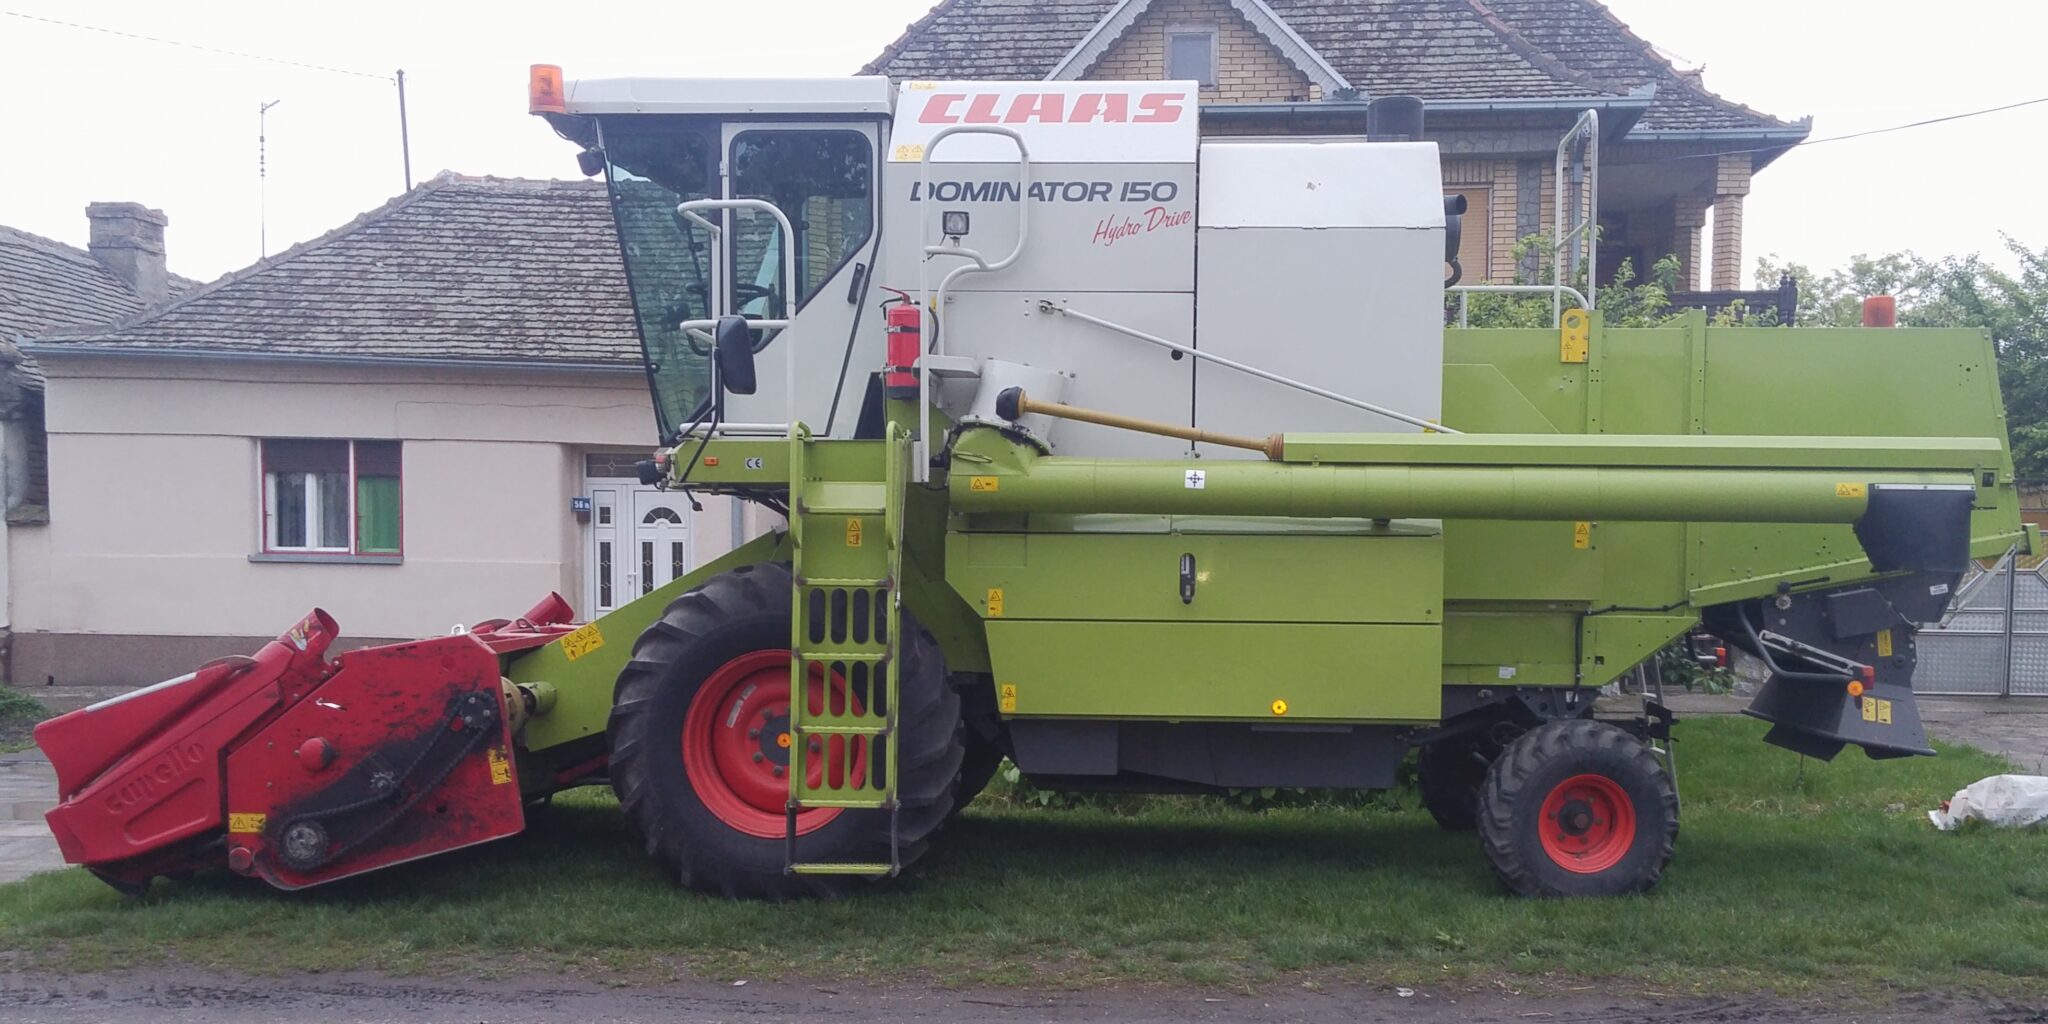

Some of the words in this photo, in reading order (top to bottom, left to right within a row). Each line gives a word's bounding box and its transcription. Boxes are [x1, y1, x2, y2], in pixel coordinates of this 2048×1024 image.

[918, 93, 1186, 123] CLAAS
[910, 181, 1113, 202] DOMINATOR
[1119, 181, 1178, 202] 150
[1092, 214, 1142, 247] Hydro
[1144, 206, 1192, 232] Drive
[746, 458, 761, 469] CE
